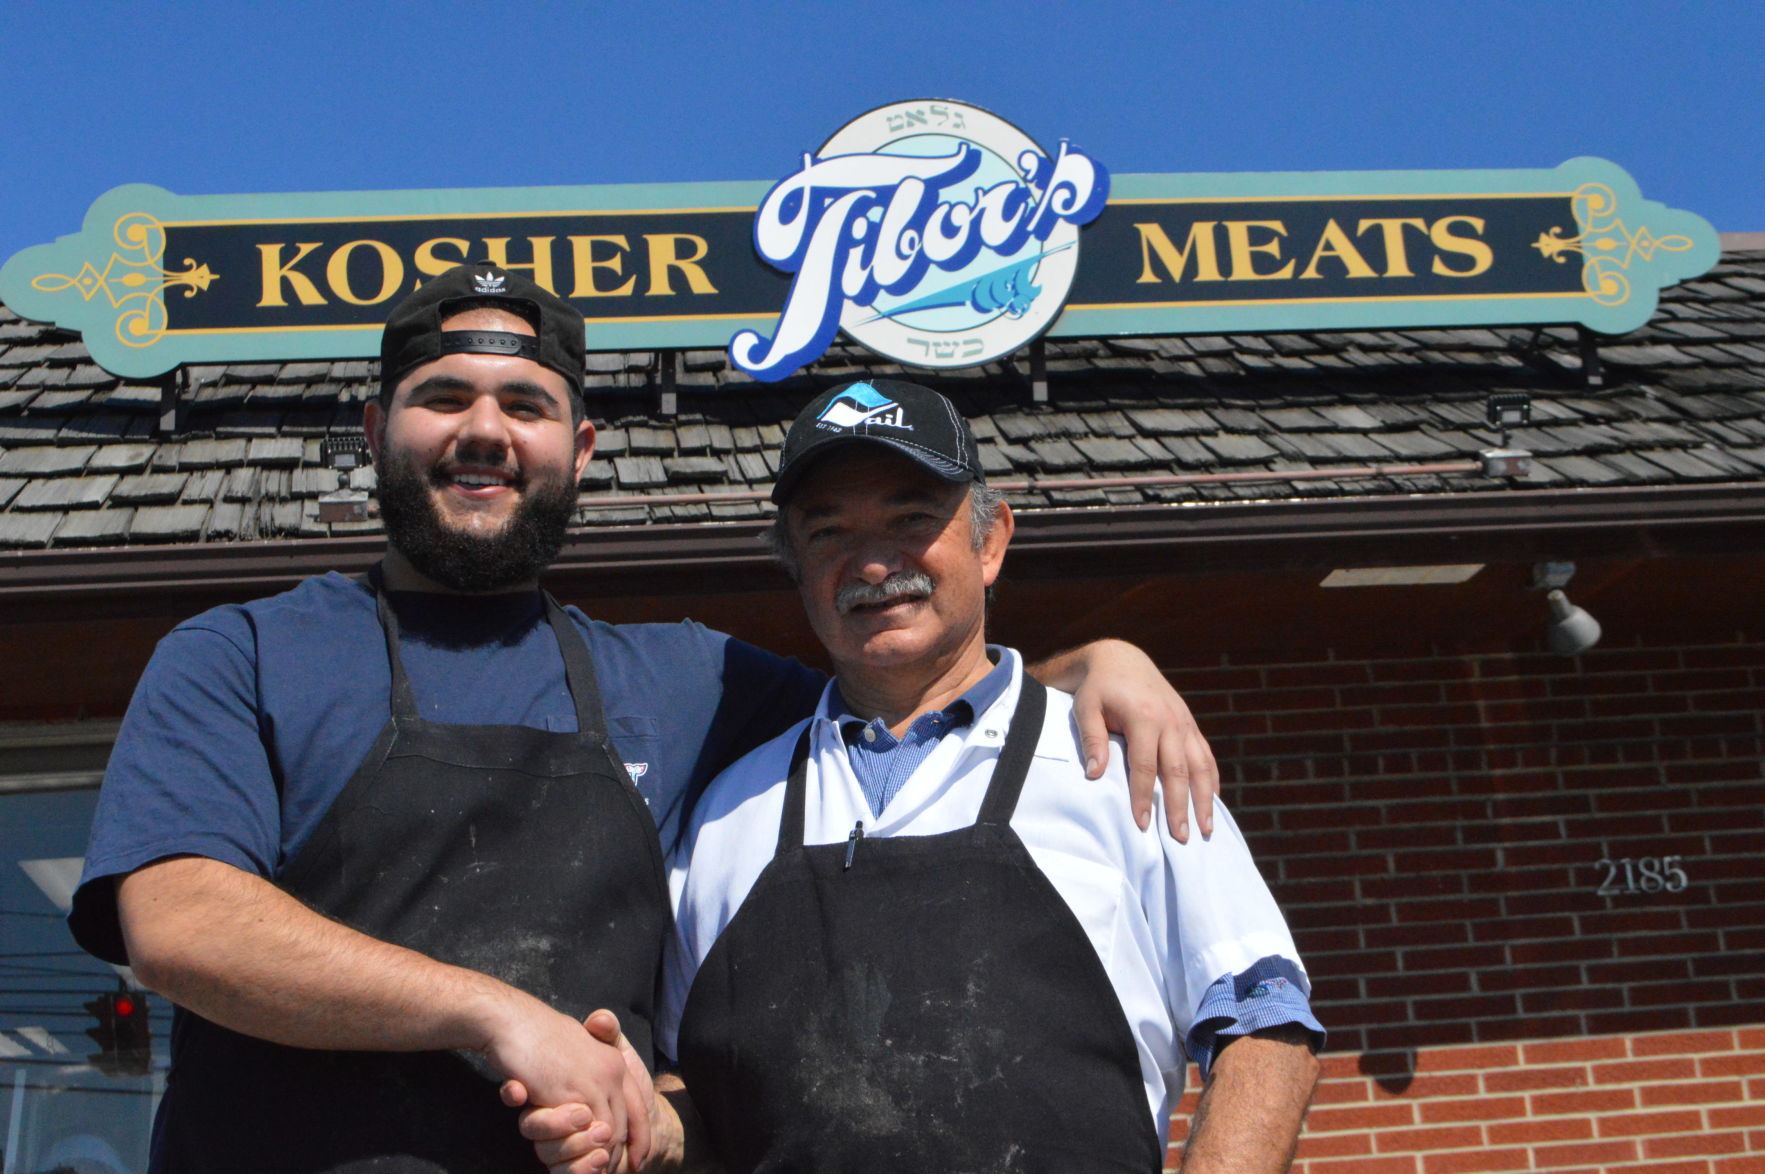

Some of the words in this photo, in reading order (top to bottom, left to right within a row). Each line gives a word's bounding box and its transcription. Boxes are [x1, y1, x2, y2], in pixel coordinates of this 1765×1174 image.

[256, 234, 719, 307] KOSHER
[729, 138, 1110, 382] Tibor's
[1133, 215, 1494, 283] MEATS
[907, 338, 984, 358] כשר
[1594, 856, 1688, 896] 2185
